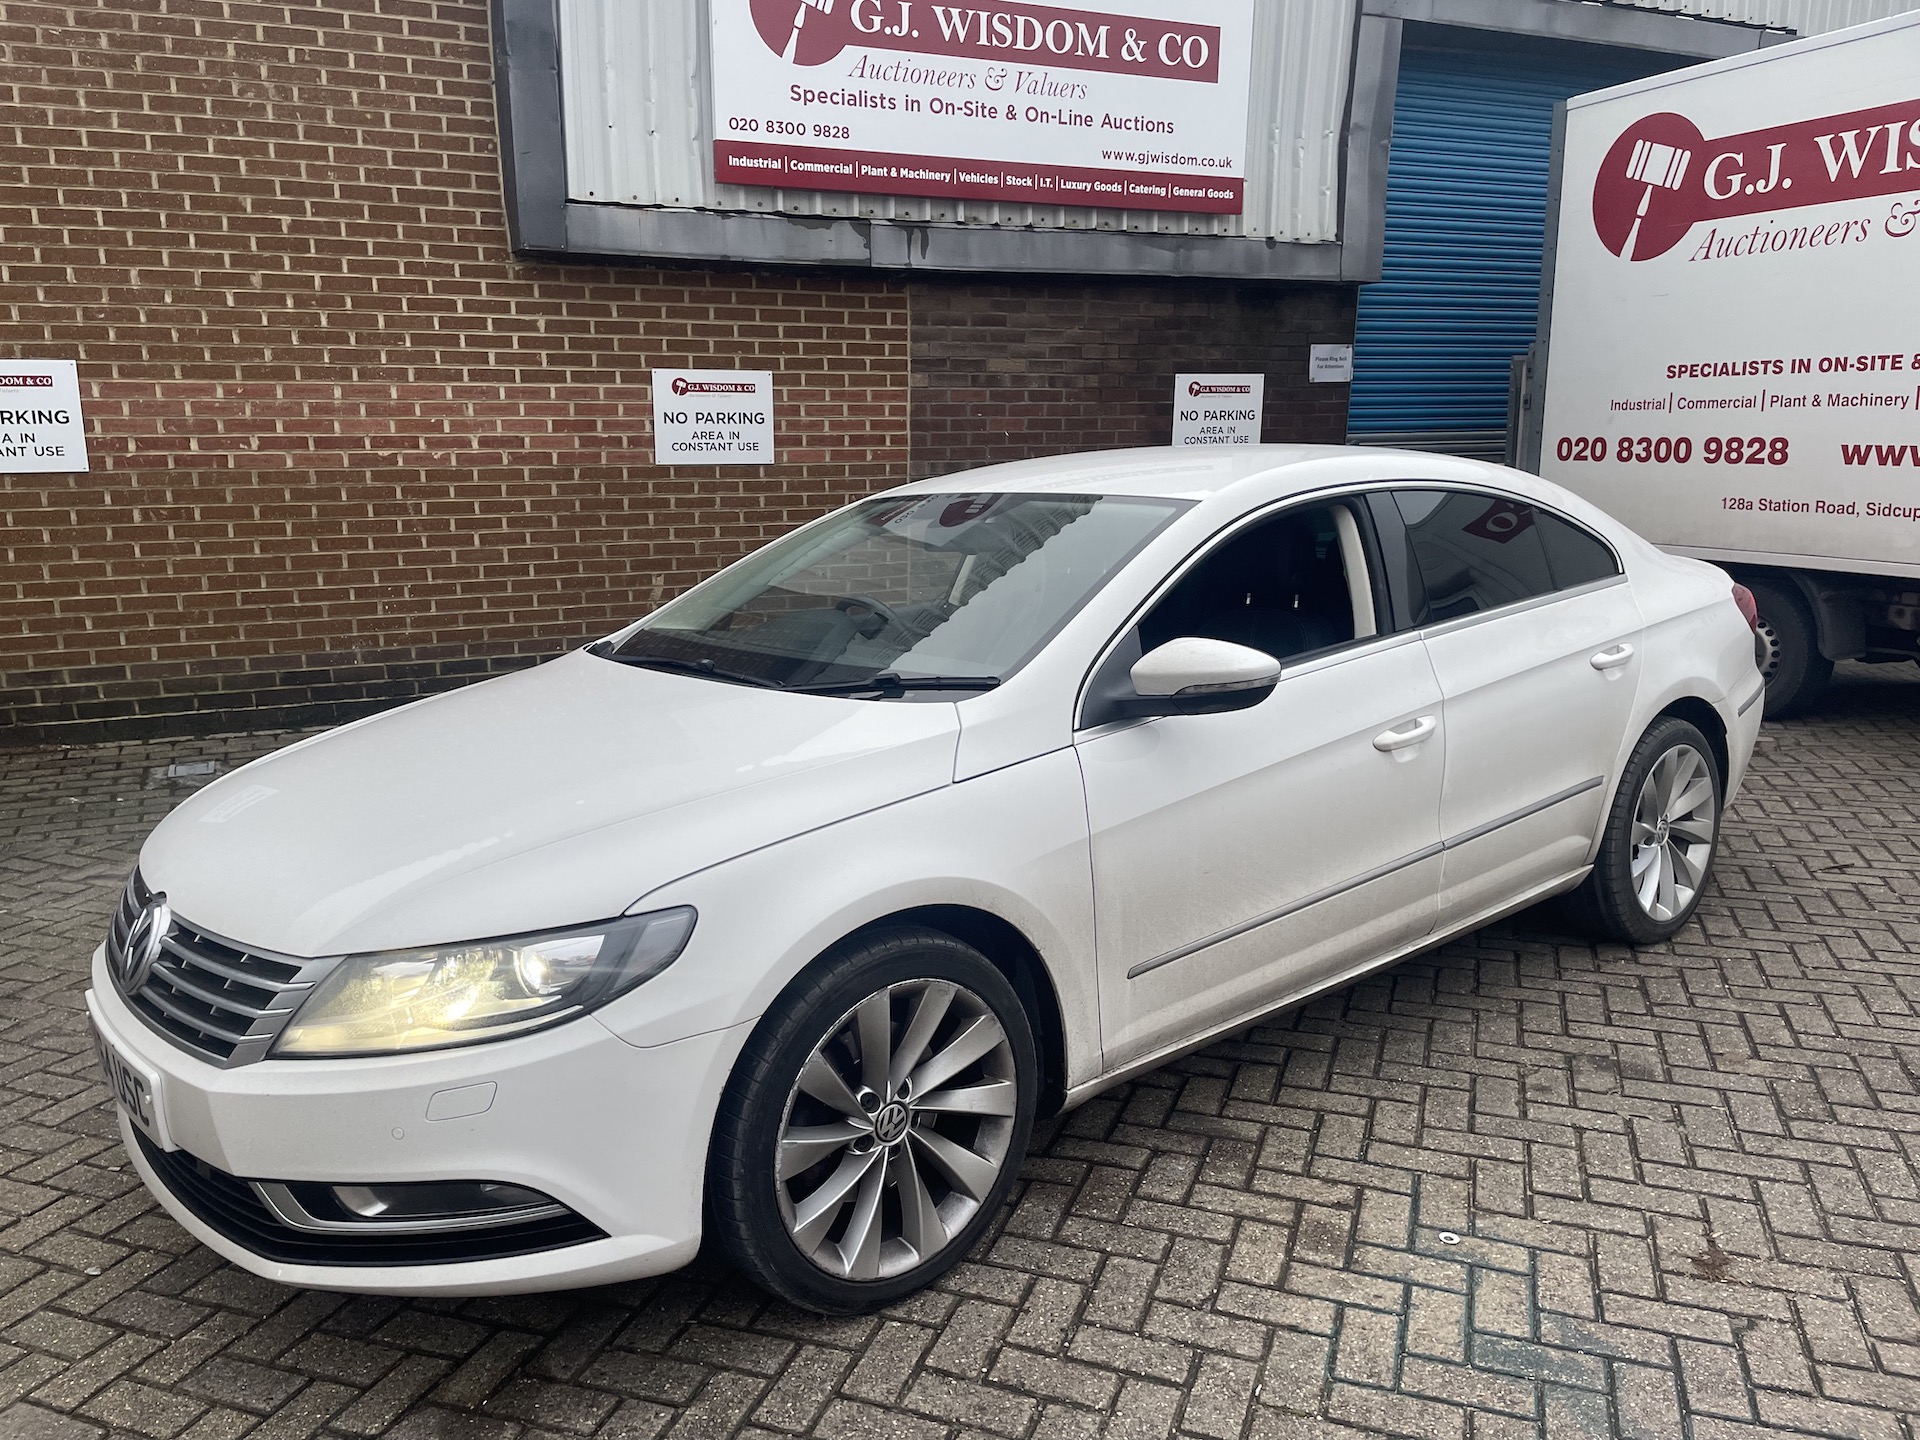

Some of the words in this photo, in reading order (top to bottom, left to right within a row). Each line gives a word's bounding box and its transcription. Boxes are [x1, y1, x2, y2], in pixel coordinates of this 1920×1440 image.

[850, 0, 919, 38] G.J.
[931, 5, 1110, 58] WISDOM
[1121, 28, 1147, 63] &
[1158, 32, 1209, 68] CO
[847, 54, 976, 90] Auctioneers
[984, 66, 1008, 91] &
[1014, 71, 1087, 99] Valuers
[790, 84, 896, 111] Specialists
[905, 95, 921, 112] in
[929, 97, 998, 119] On-Site
[1005, 104, 1017, 120] &
[1025, 106, 1093, 127] On-Line
[1100, 113, 1174, 134] Auctions
[728, 117, 759, 132] 020
[766, 120, 806, 136] 8300
[813, 124, 850, 139] 9828
[1101, 149, 1233, 170] www.gjwisdom.co.uk
[728, 155, 781, 170] Industrial
[790, 159, 853, 175] Commercial
[861, 164, 888, 177] Plant
[890, 167, 898, 178] &
[900, 167, 951, 183] Machinery
[959, 171, 998, 185] Vehicles
[1006, 175, 1032, 187] Stock
[1040, 177, 1053, 188] I.T.
[1060, 178, 1091, 192] Luxury
[1094, 181, 1122, 193] Goods
[1129, 183, 1166, 196] Catering
[1173, 186, 1205, 198] General
[1207, 188, 1234, 199] Goods
[1703, 142, 1793, 200] G.J.
[1688, 219, 1871, 262] Auctioneers
[1666, 359, 1784, 379] SPECIALISTS
[1791, 358, 1811, 374] IN
[1818, 354, 1904, 373] ON-SITE
[26, 377, 34, 385] &
[36, 377, 52, 385] CO
[743, 384, 755, 392] CO
[1610, 398, 1666, 412] Industrial
[1677, 395, 1757, 410] Commercial
[1770, 393, 1807, 409] Plant
[1812, 394, 1822, 407] &
[1827, 391, 1910, 410] Machinery
[663, 411, 688, 424] NO
[695, 412, 765, 424] PARKING
[1180, 410, 1198, 421] NO
[1203, 410, 1255, 421] PARKING
[20, 433, 35, 443] IN
[692, 431, 724, 440] AREA
[729, 431, 740, 440] IN
[1184, 436, 1230, 445] CONSTANT
[1233, 435, 1249, 444] USE
[1200, 426, 1224, 435] AREA
[1227, 426, 1236, 434] IN
[34, 446, 65, 457] USE
[672, 442, 733, 451] CONSTANT
[737, 442, 759, 451] USE
[1556, 436, 1608, 463] 020
[1616, 436, 1692, 463] 8300
[1703, 437, 1789, 465] 9828
[1721, 498, 1753, 511] 128a
[1758, 498, 1810, 513] Station
[1815, 500, 1860, 518] Road,
[1866, 503, 1920, 522] Sidcup
